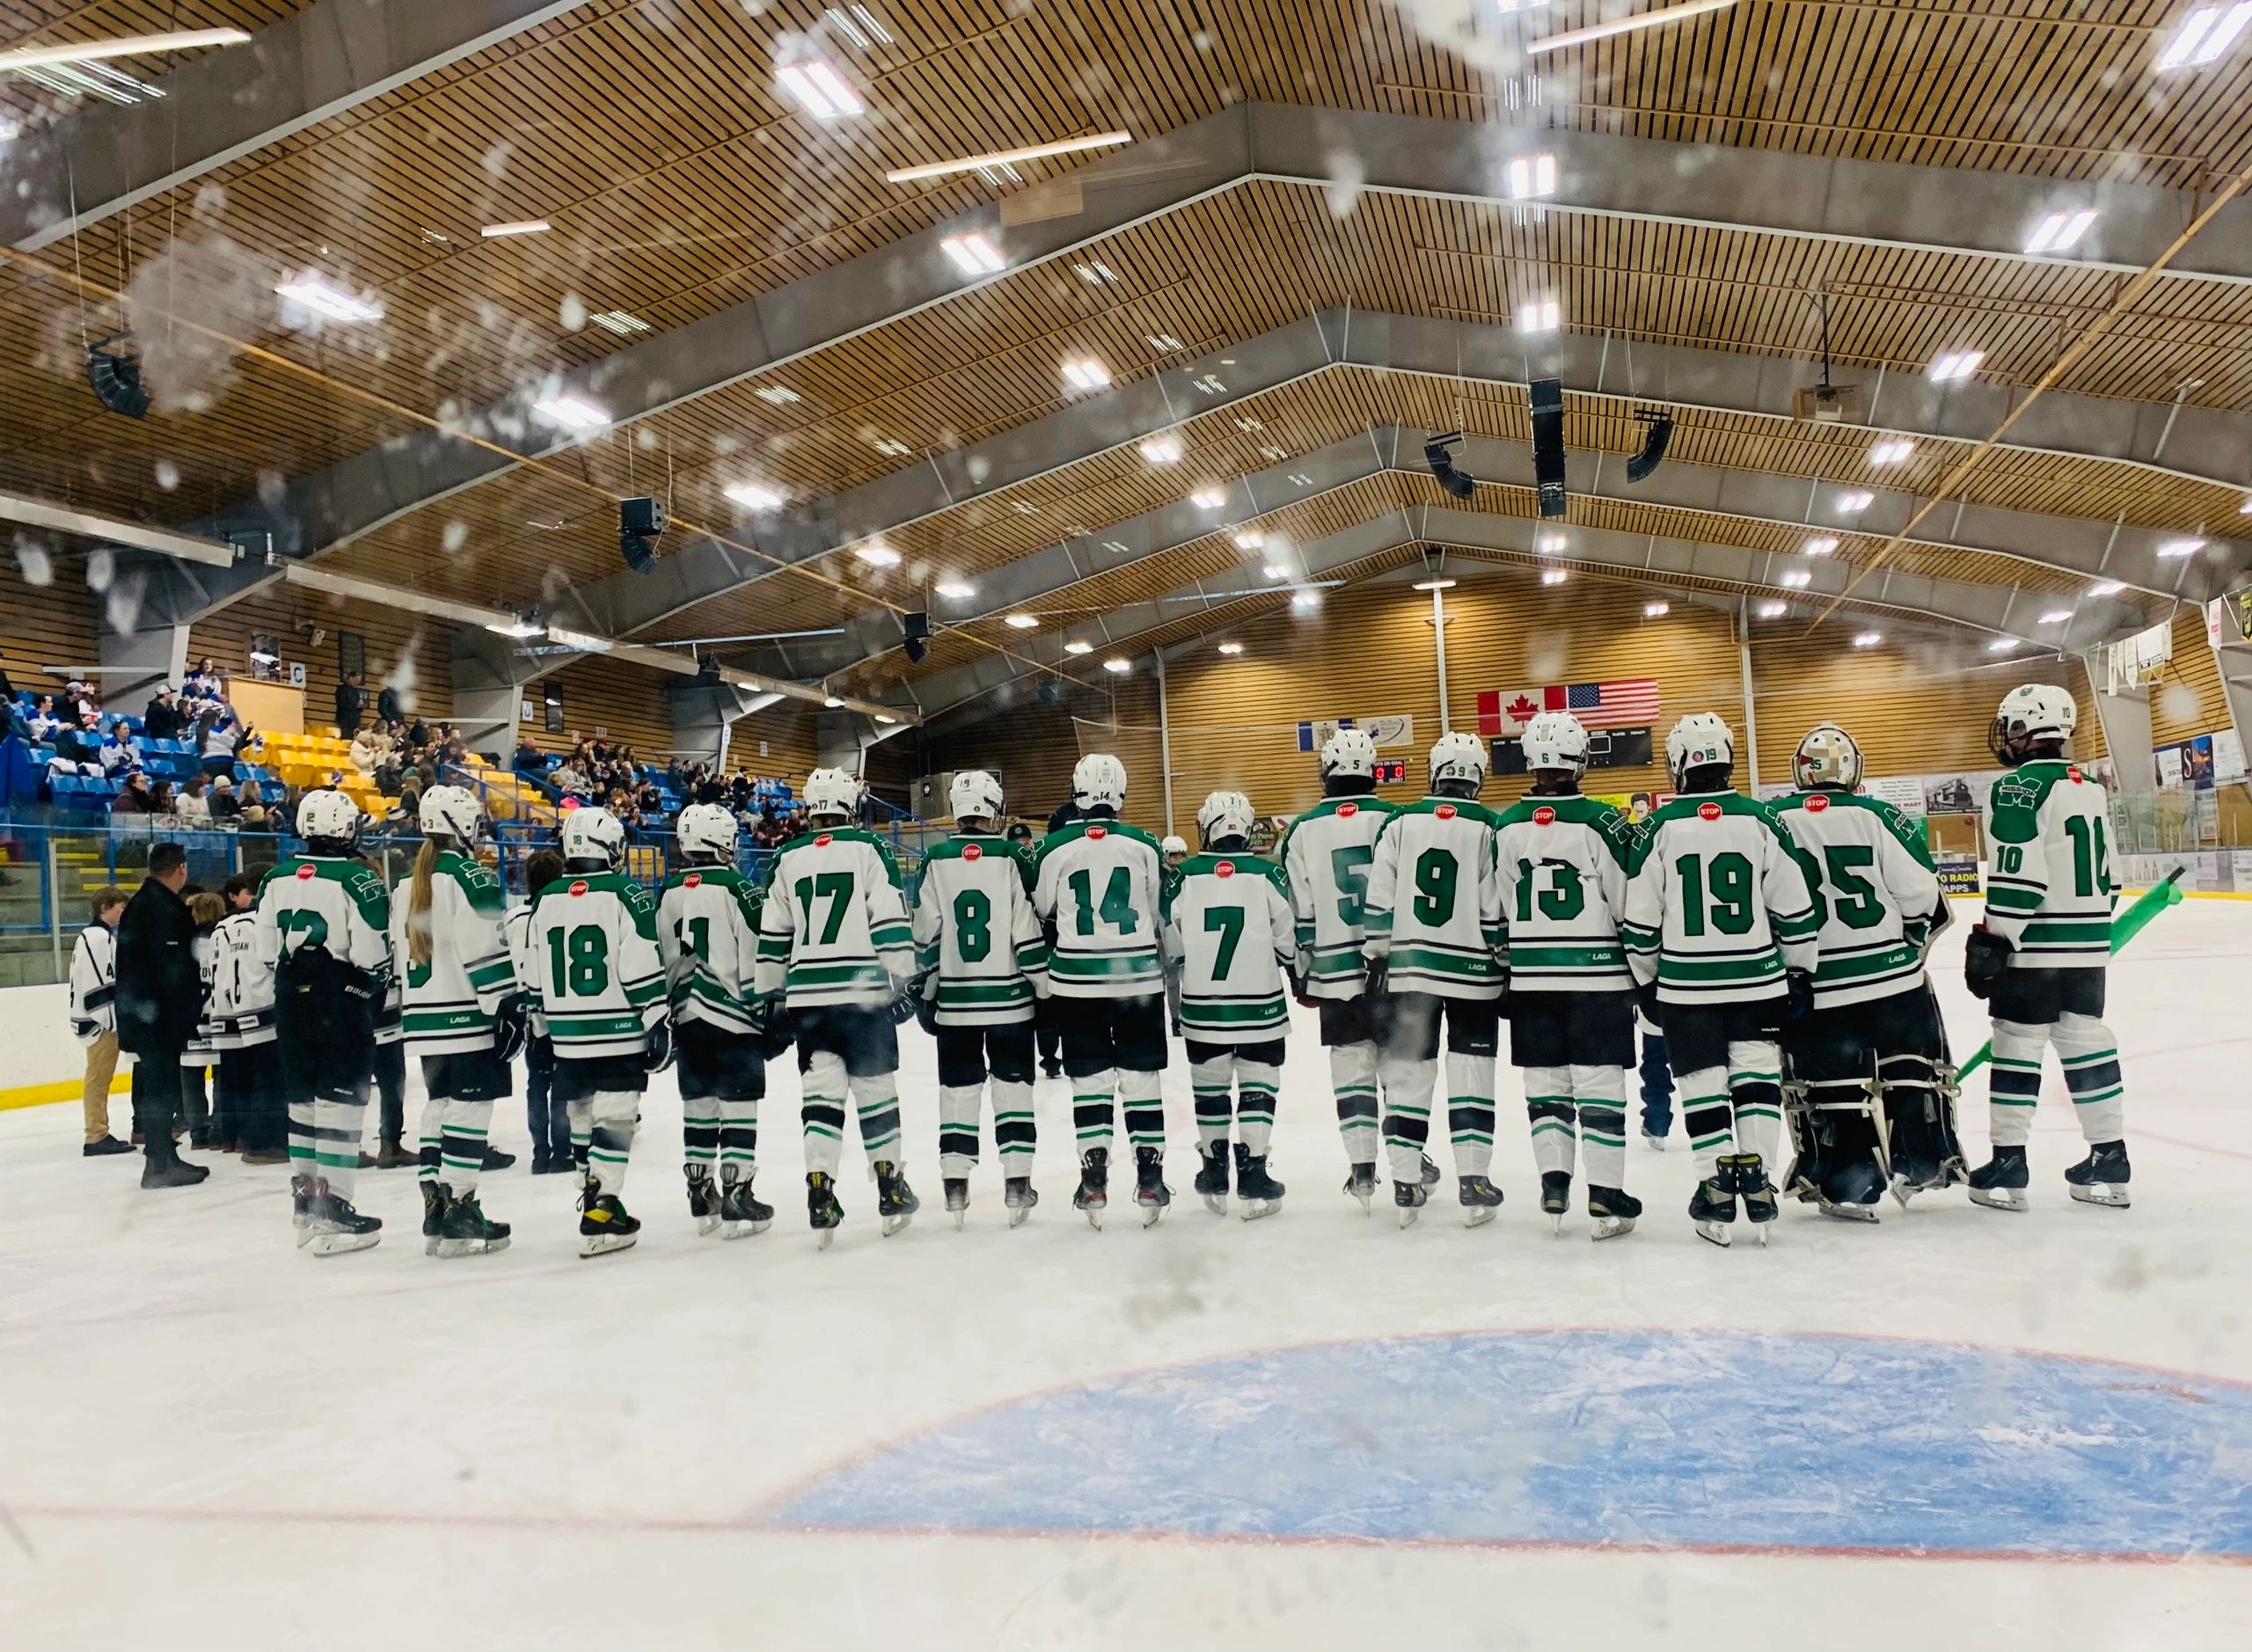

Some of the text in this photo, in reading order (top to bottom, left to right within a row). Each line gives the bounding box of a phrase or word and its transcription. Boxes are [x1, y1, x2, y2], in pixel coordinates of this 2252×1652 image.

[293, 666, 303, 683] C
[1541, 752, 1549, 764] 6
[1705, 748, 1716, 761] 19
[1352, 759, 1360, 770] 5
[1376, 767, 1385, 778] 0
[1394, 765, 1403, 778] 0
[1458, 766, 1466, 777] 9
[1100, 791, 1110, 801] 14
[818, 800, 829, 810] 17
[1806, 799, 1827, 808] STOP
[1535, 811, 1554, 820] STOP
[427, 819, 434, 829] 3
[684, 824, 691, 833] 3
[573, 835, 582, 844] 18
[1996, 845, 2023, 874] 10
[685, 876, 701, 885] STOP
[1949, 873, 1978, 883] RADIO
[1331, 844, 1372, 926] 5
[1413, 847, 1459, 928] 9
[1515, 857, 1585, 922] 13
[1945, 883, 1970, 894] APPS
[1676, 852, 1755, 937] 19
[1068, 866, 1139, 936] 14
[794, 872, 855, 947] 17
[954, 888, 991, 963] 8
[1204, 905, 1245, 982] 7
[546, 924, 609, 998] 18
[450, 1016, 471, 1025] LAGA
[615, 1021, 632, 1030] LAGA
